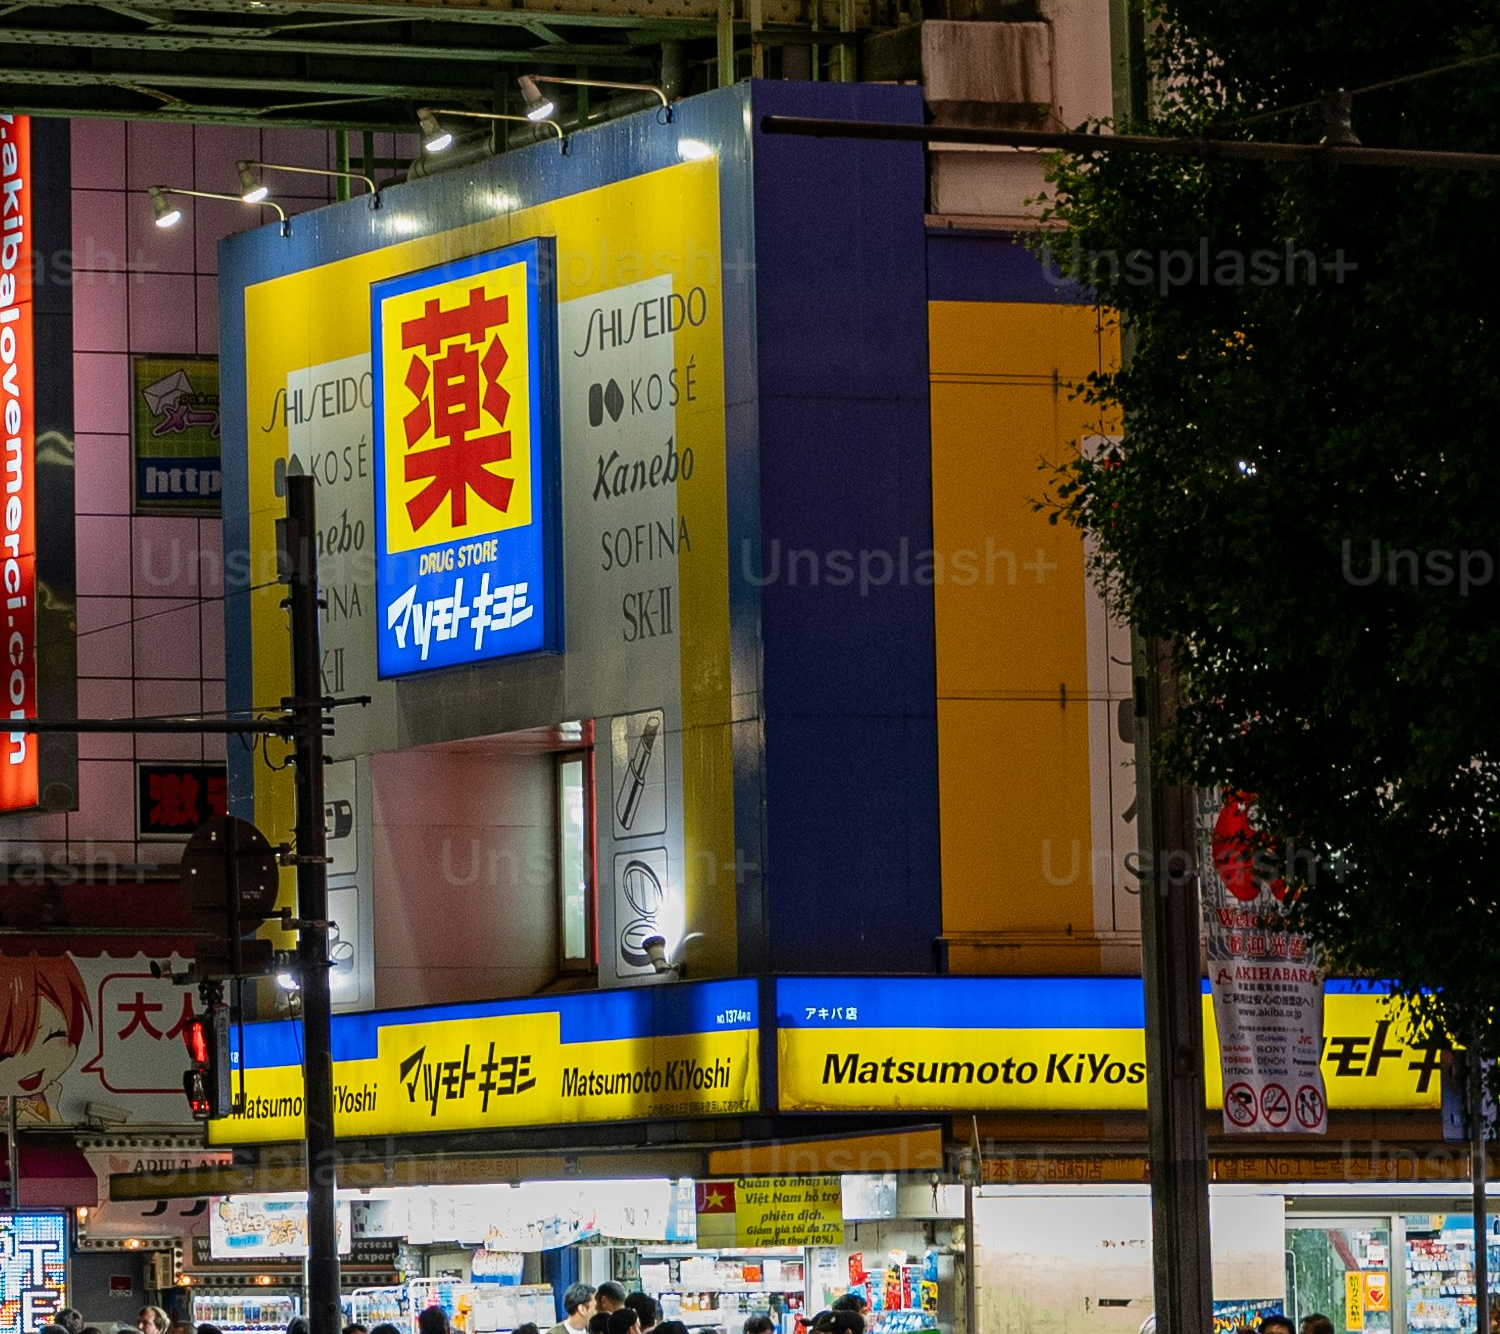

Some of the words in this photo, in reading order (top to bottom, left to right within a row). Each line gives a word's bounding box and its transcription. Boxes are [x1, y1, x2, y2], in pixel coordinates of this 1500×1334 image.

[574, 286, 707, 357] SHISEIDO
[630, 355, 697, 416] KOSÉ
[401, 285, 514, 533] 薬
[310, 434, 368, 488] KOSÉ
[592, 435, 695, 502] Kanebo
[418, 548, 454, 576] DRUG
[457, 538, 499, 569] STORE
[601, 515, 692, 572] SOFINA
[1235, 965, 1317, 983] AKIHABARA
[804, 1006, 858, 1022] アキバ店
[561, 1066, 660, 1098] Matsumoto
[664, 1057, 731, 1092] KiYoshi
[822, 1052, 1039, 1084] Matsumoto
[1045, 1052, 1147, 1084] KiYos
[133, 1158, 191, 1174] ADULT
[745, 1192, 770, 1204] Việt
[772, 1192, 802, 1204] Nam
[804, 1188, 820, 1203] hỗ
[760, 1210, 795, 1225] phiên
[797, 1209, 825, 1221] dịch.
[822, 1222, 840, 1233] 17%
[810, 1233, 834, 1245] 10%)
